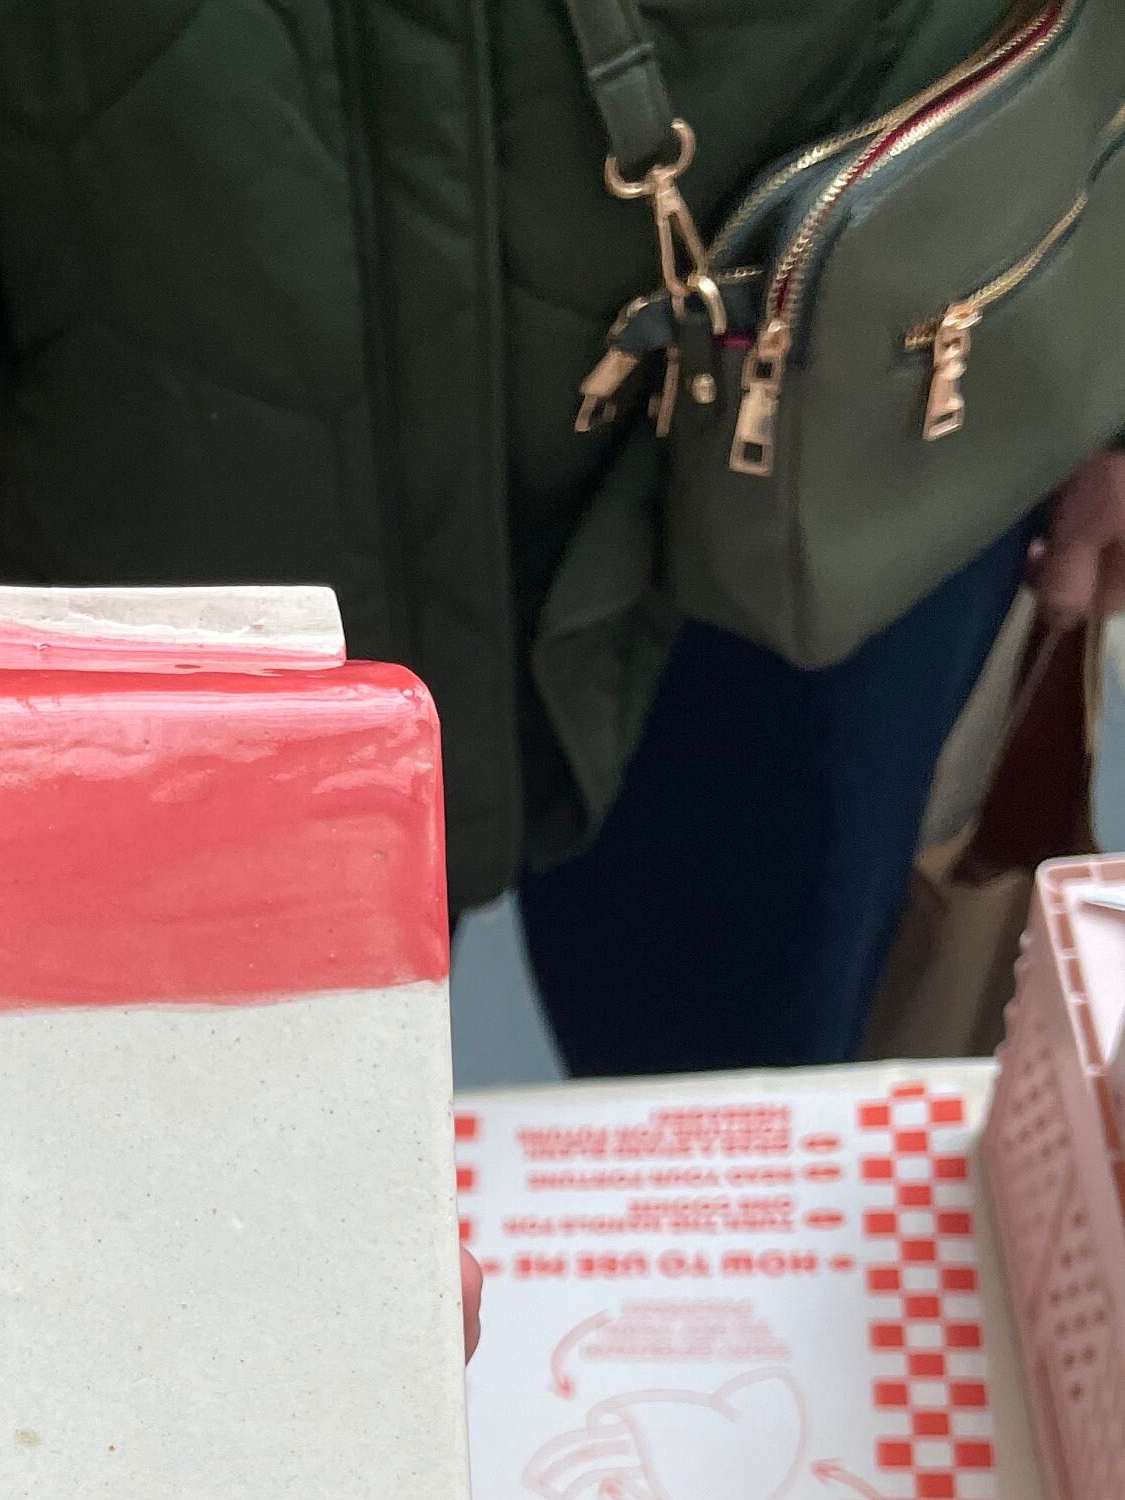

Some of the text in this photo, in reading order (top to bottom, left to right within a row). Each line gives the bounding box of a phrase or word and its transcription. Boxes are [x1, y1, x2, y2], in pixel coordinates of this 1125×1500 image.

[515, 1250, 818, 1279] HOW TO USE ME
